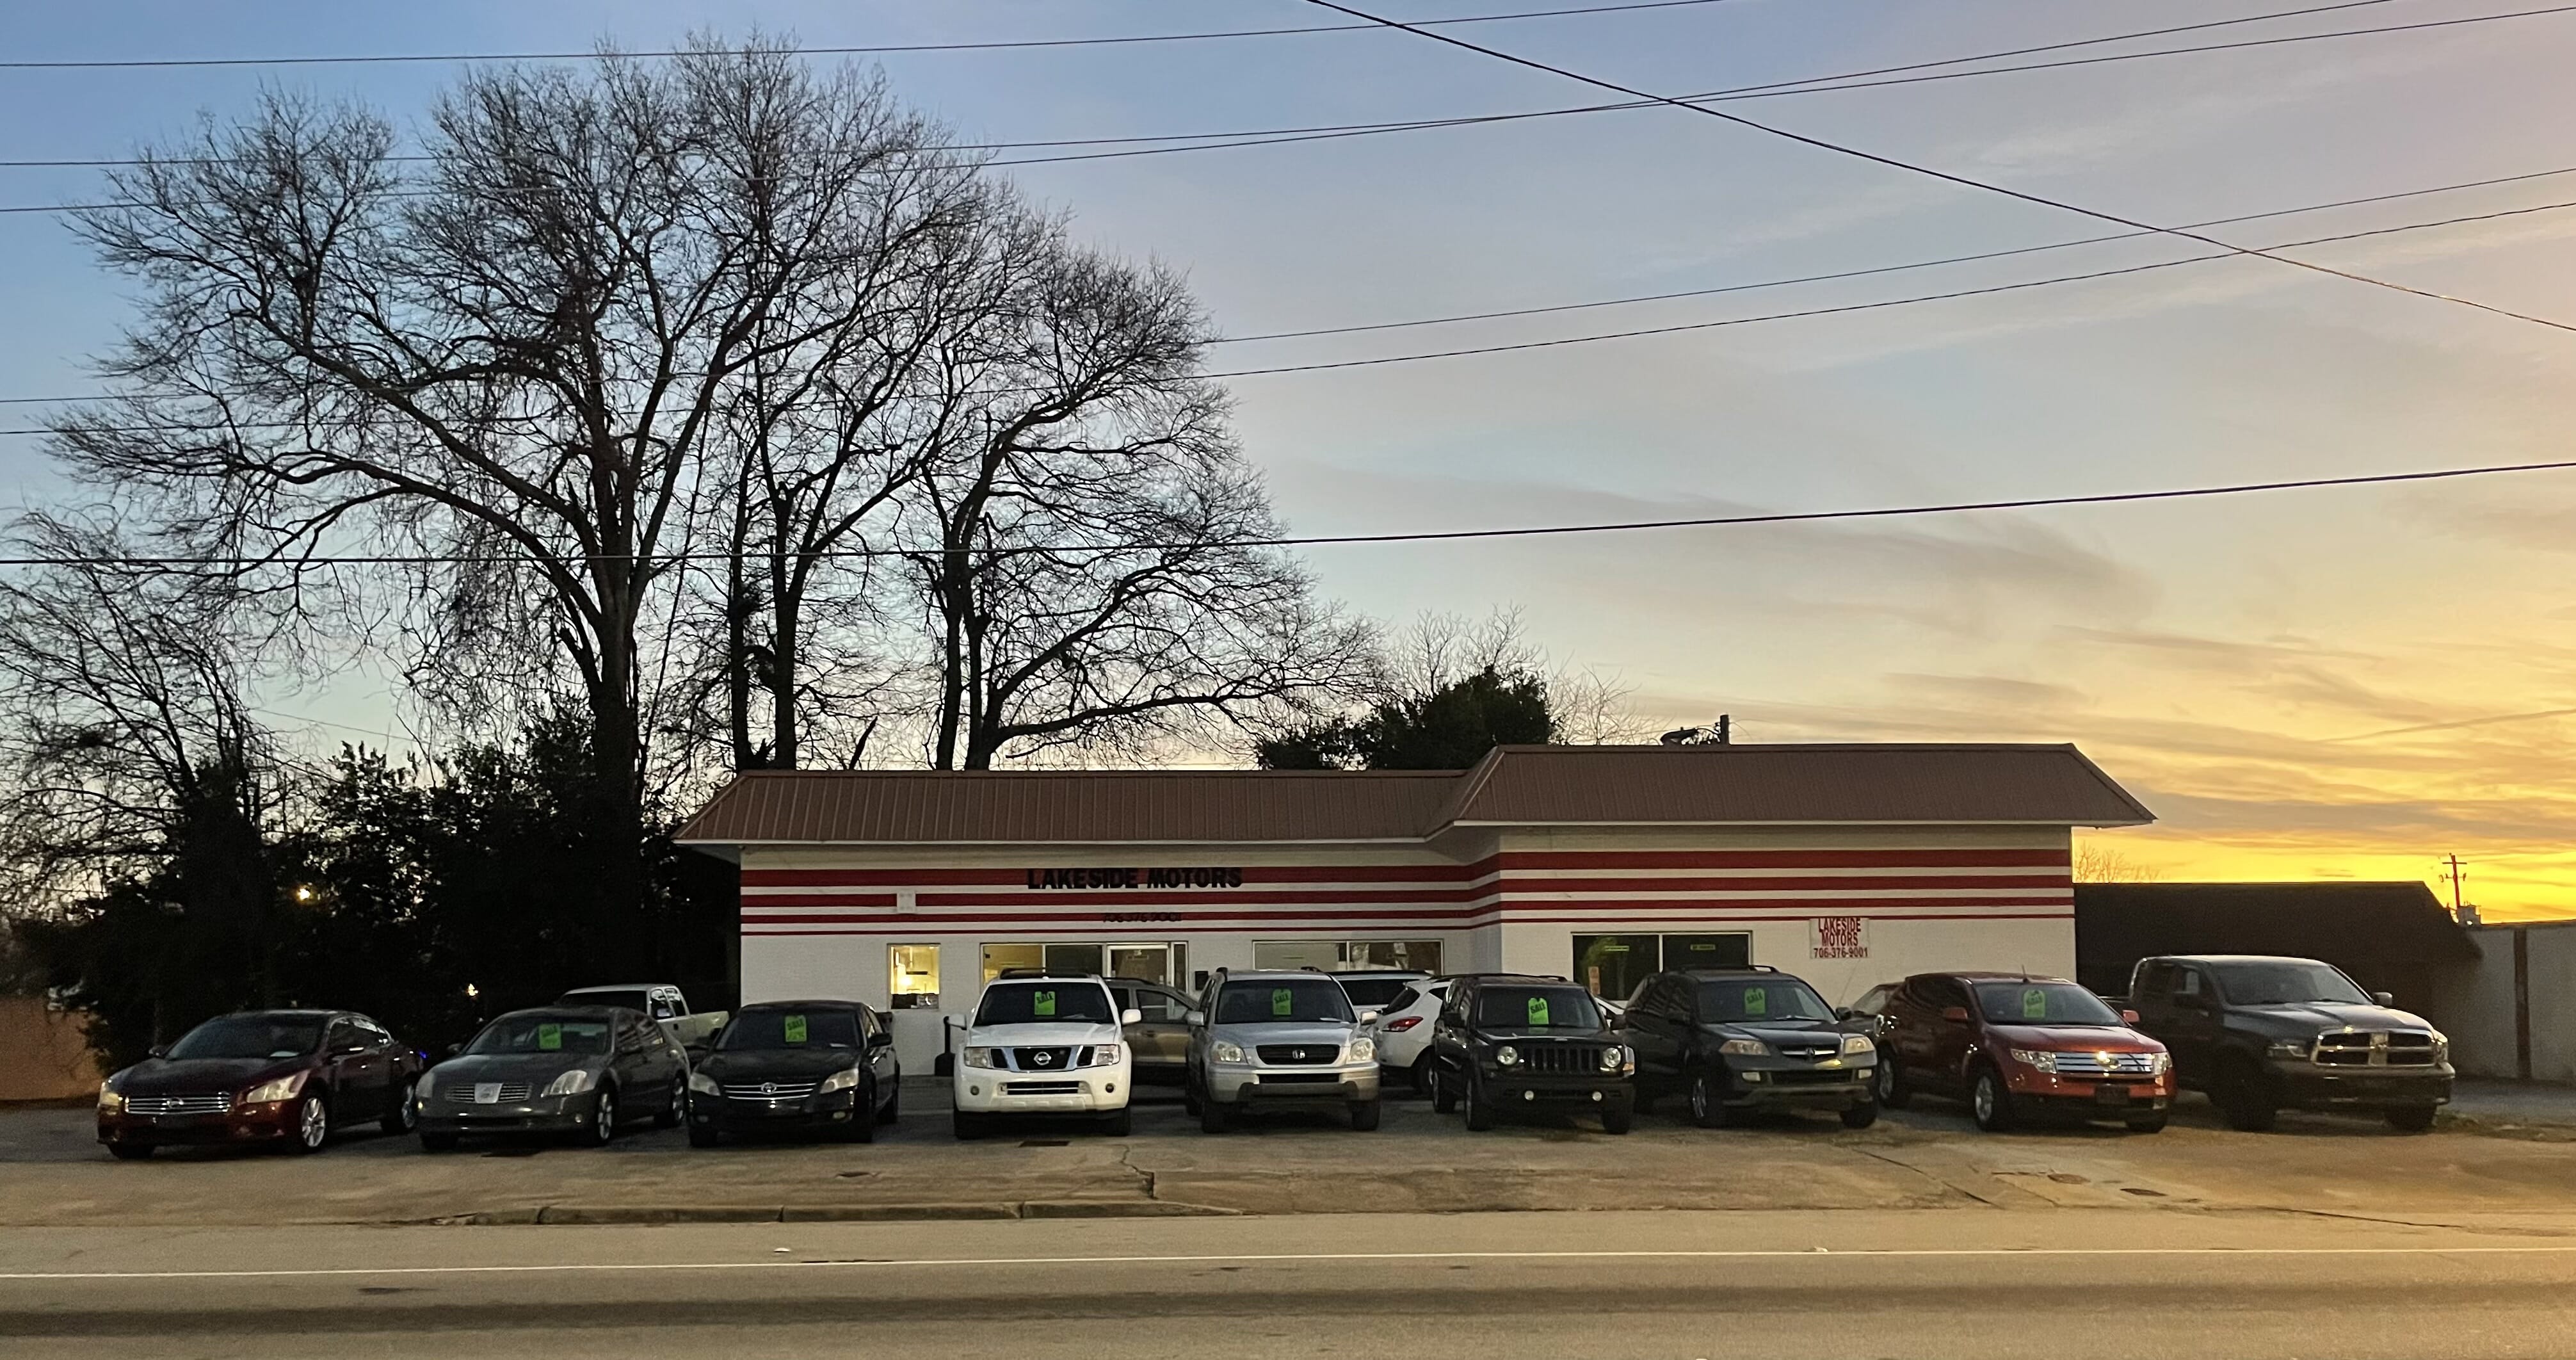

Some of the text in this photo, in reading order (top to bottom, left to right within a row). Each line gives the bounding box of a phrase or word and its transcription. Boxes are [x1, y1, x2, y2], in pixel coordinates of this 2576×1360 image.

[1027, 866, 1244, 889] LAKESIDE MOTORS
[1818, 917, 1862, 933] LAKESIDE
[1821, 932, 1858, 947] MOTORS
[1813, 947, 1868, 959] 706-376-9001
[1036, 992, 1054, 1004] SALE
[1273, 992, 1290, 1005] SALE
[1530, 1001, 1546, 1014] SALE
[787, 1018, 805, 1031] SALE
